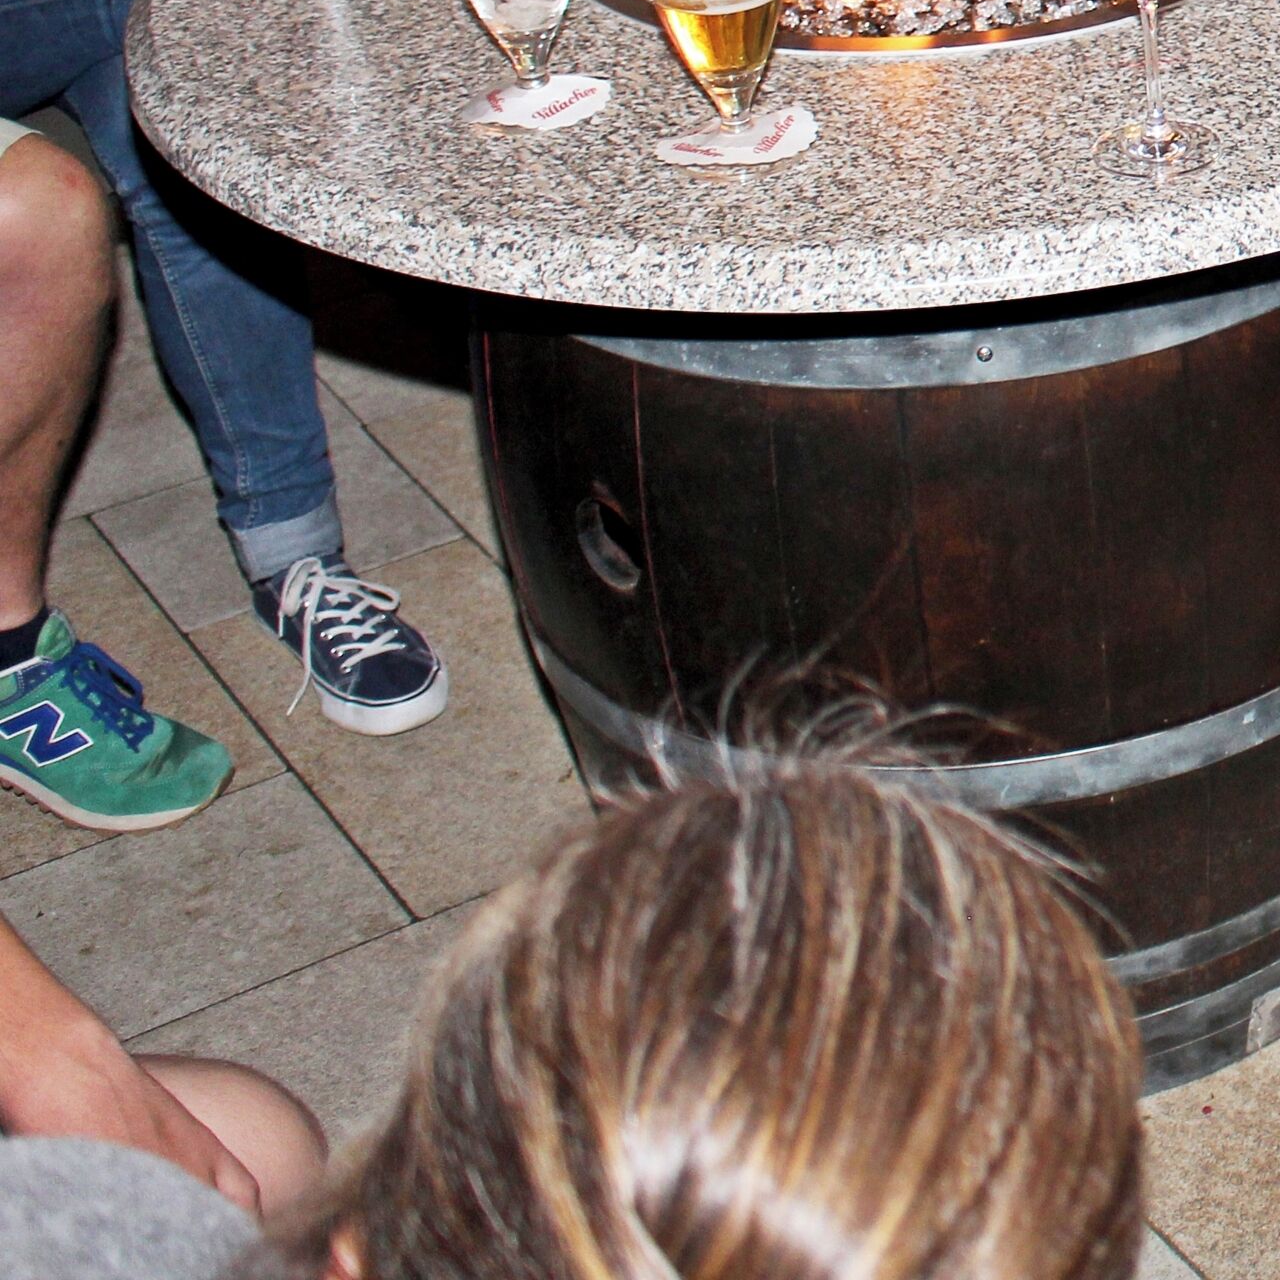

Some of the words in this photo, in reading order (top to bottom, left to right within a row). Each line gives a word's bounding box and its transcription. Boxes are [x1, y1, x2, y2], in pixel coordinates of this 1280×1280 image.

[531, 86, 598, 120] Villacher
[753, 114, 795, 154] Villacher
[0, 700, 93, 767] N
